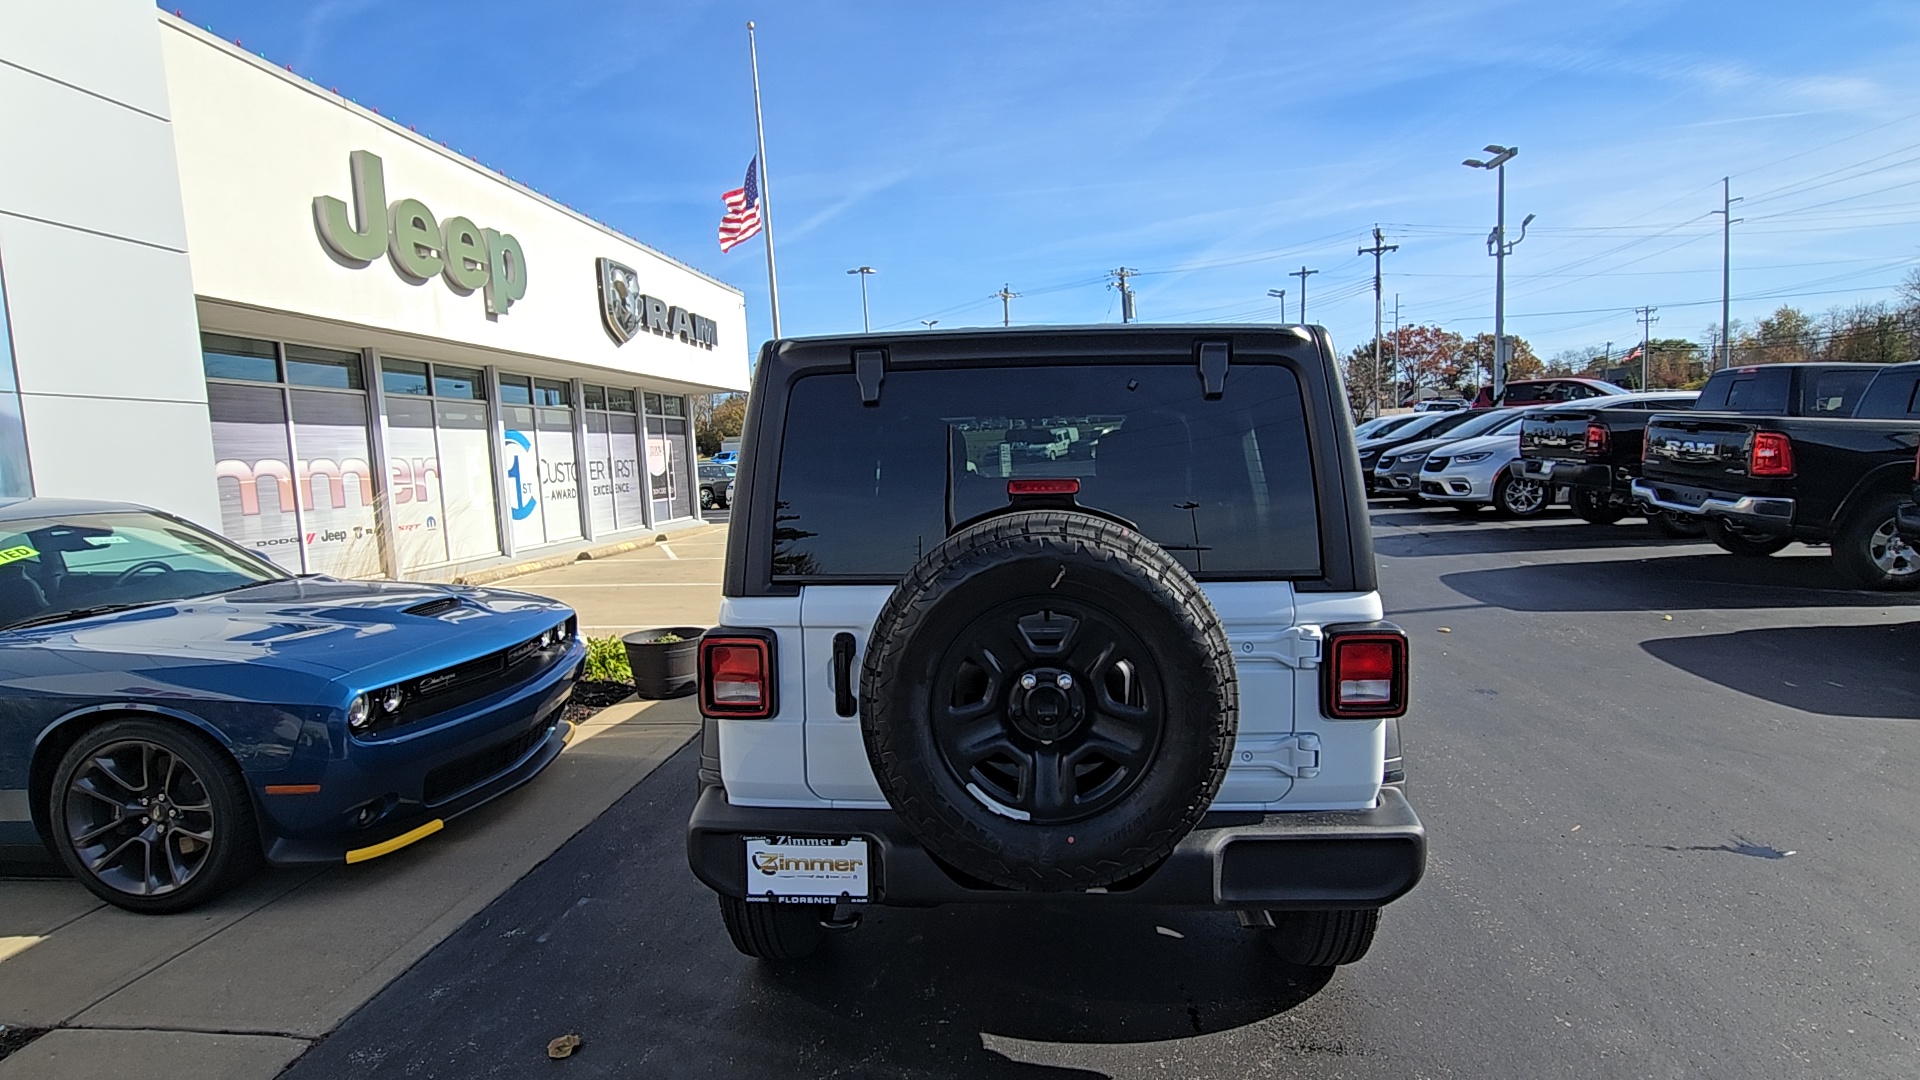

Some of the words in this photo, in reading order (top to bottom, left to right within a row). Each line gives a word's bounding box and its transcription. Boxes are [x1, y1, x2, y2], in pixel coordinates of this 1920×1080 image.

[312, 149, 527, 323] Jeep
[640, 294, 718, 350] RAM
[1533, 426, 1568, 437] RAM
[1665, 440, 1715, 454] RAM
[540, 458, 605, 484] CUSTOER
[551, 488, 577, 501] AWARD
[593, 482, 630, 496] EXCELENCE
[321, 530, 347, 543] Jeep
[776, 835, 834, 847] Zimmer
[758, 852, 864, 873] Zimmer
[778, 896, 837, 904] FLORENCE
